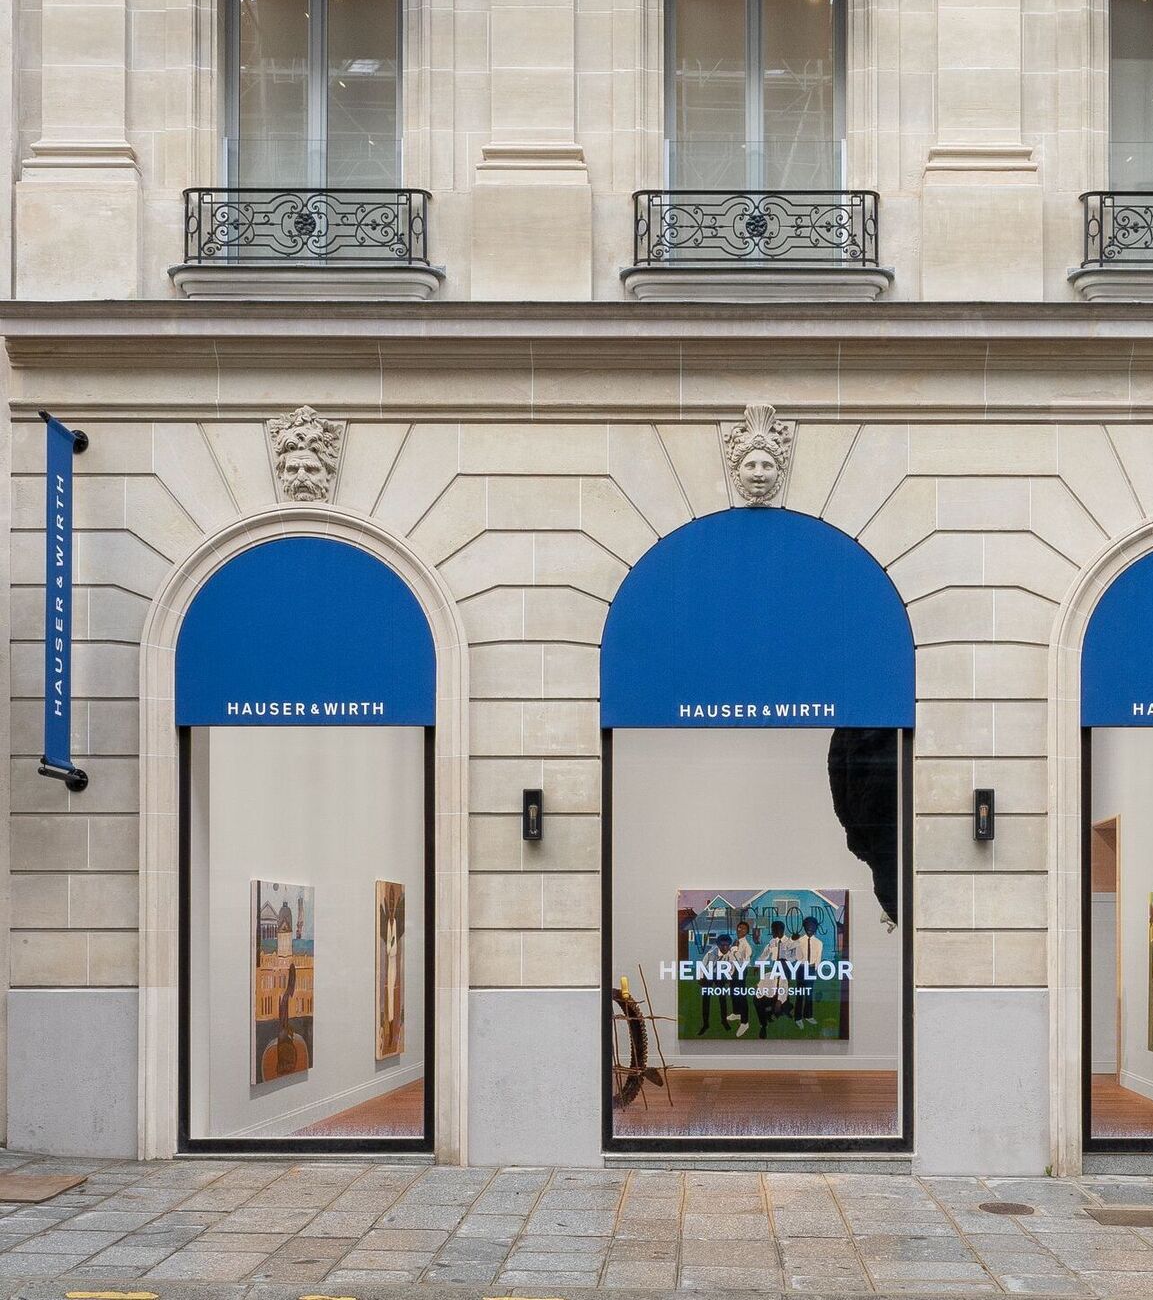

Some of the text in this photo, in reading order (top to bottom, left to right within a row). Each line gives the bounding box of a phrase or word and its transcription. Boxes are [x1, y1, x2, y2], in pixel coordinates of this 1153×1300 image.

[54, 474, 64, 717] HAUSER & WIRTH
[227, 702, 384, 716] HAUSER & WIRTH
[679, 703, 835, 718] HAUSER & WIRTH
[659, 960, 854, 981] HENRY TAYLOR
[701, 986, 812, 997] FROM SUGAR TO SHIT
